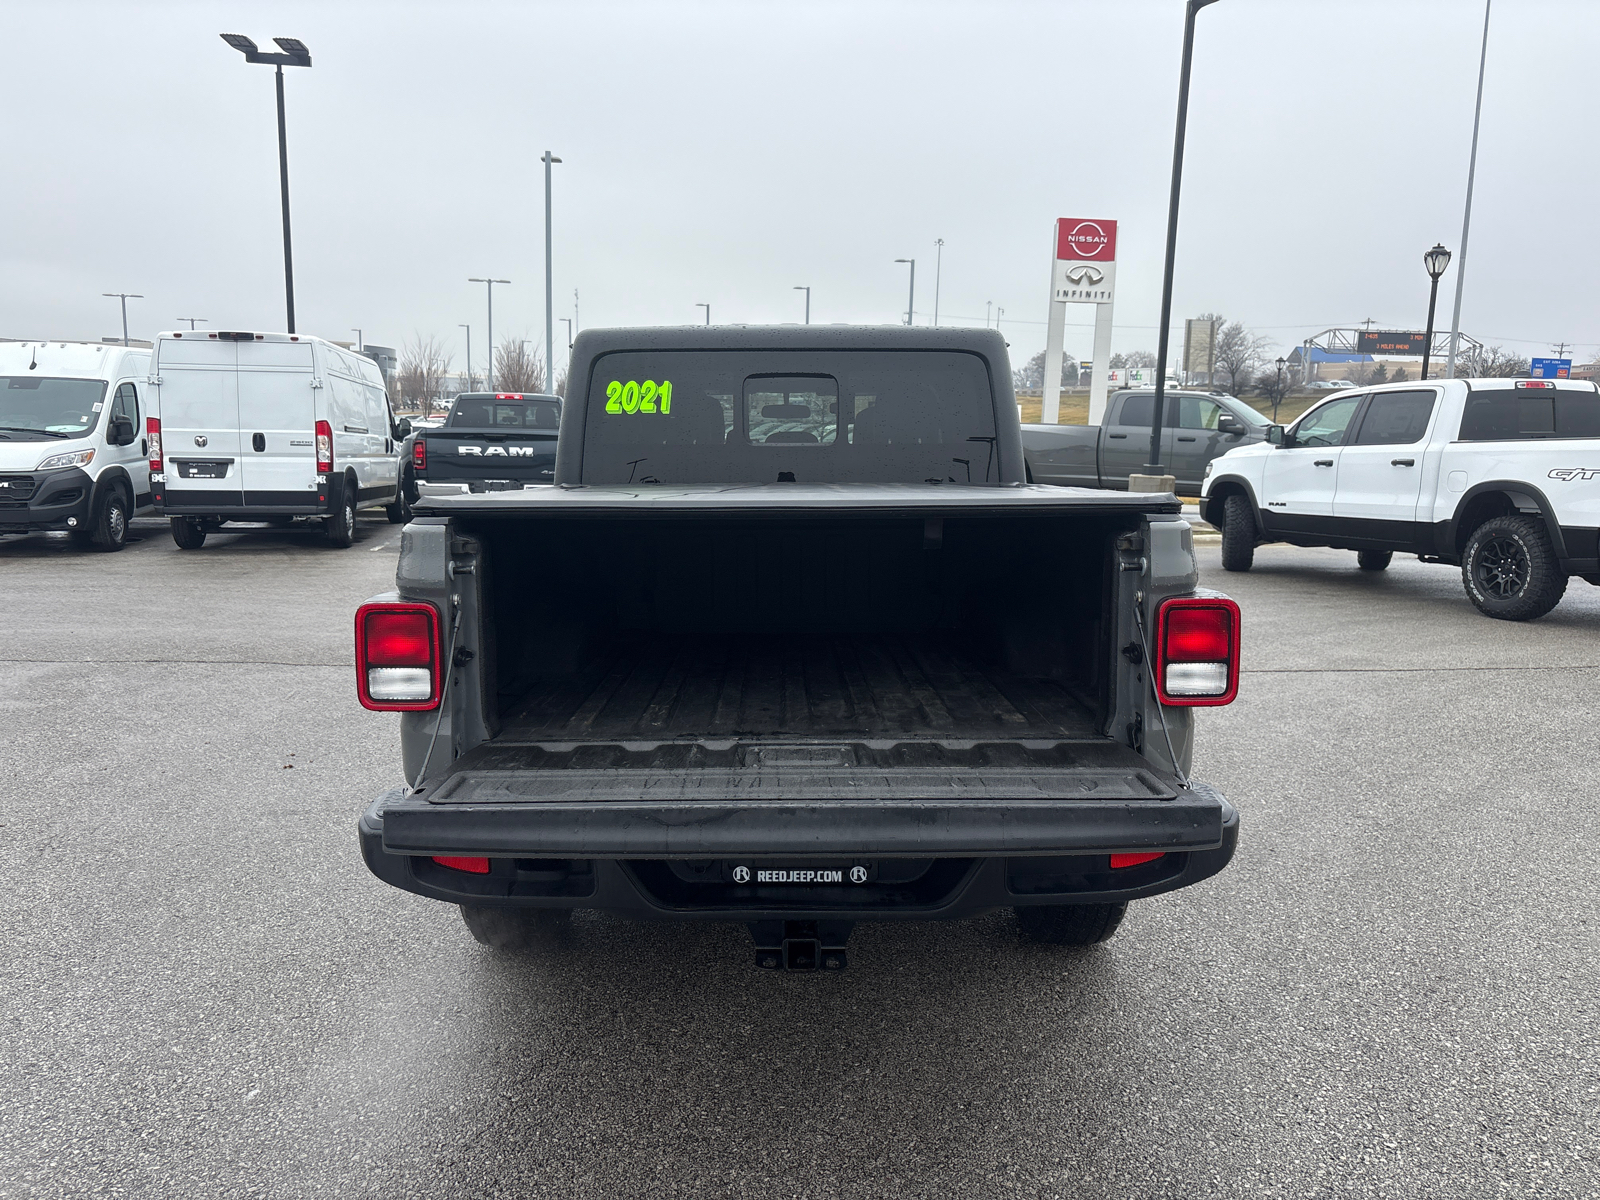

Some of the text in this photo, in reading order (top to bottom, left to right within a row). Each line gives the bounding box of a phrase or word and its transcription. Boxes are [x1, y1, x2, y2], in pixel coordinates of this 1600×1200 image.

[1068, 235, 1108, 243] NISSAN
[1056, 289, 1111, 299] INFINITI
[605, 380, 673, 415] 2021
[458, 446, 534, 457] RAM
[757, 870, 842, 882] REEDJEEP.COM
